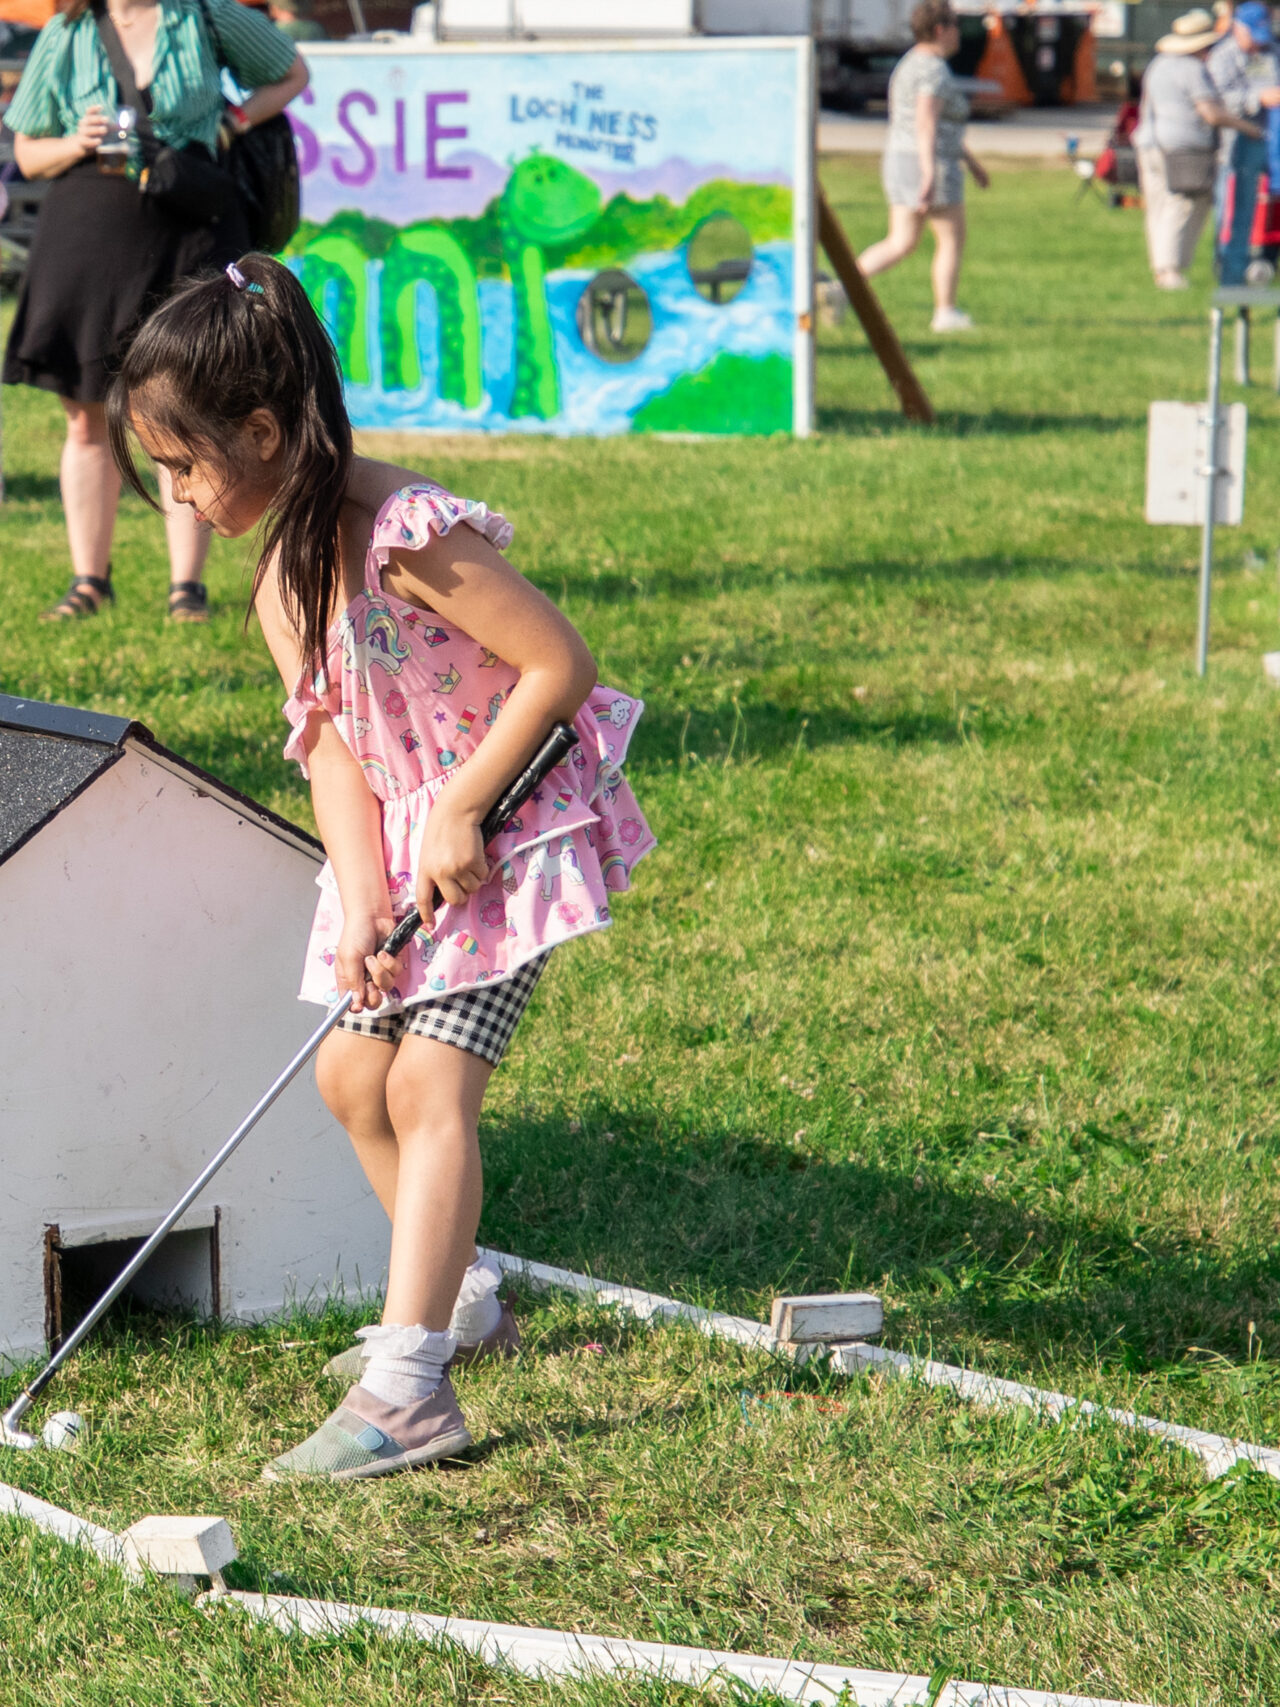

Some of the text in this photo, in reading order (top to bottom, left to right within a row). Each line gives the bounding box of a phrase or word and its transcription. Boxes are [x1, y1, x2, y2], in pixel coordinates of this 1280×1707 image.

[571, 81, 604, 100] THE
[510, 94, 658, 142] LOCH NESS
